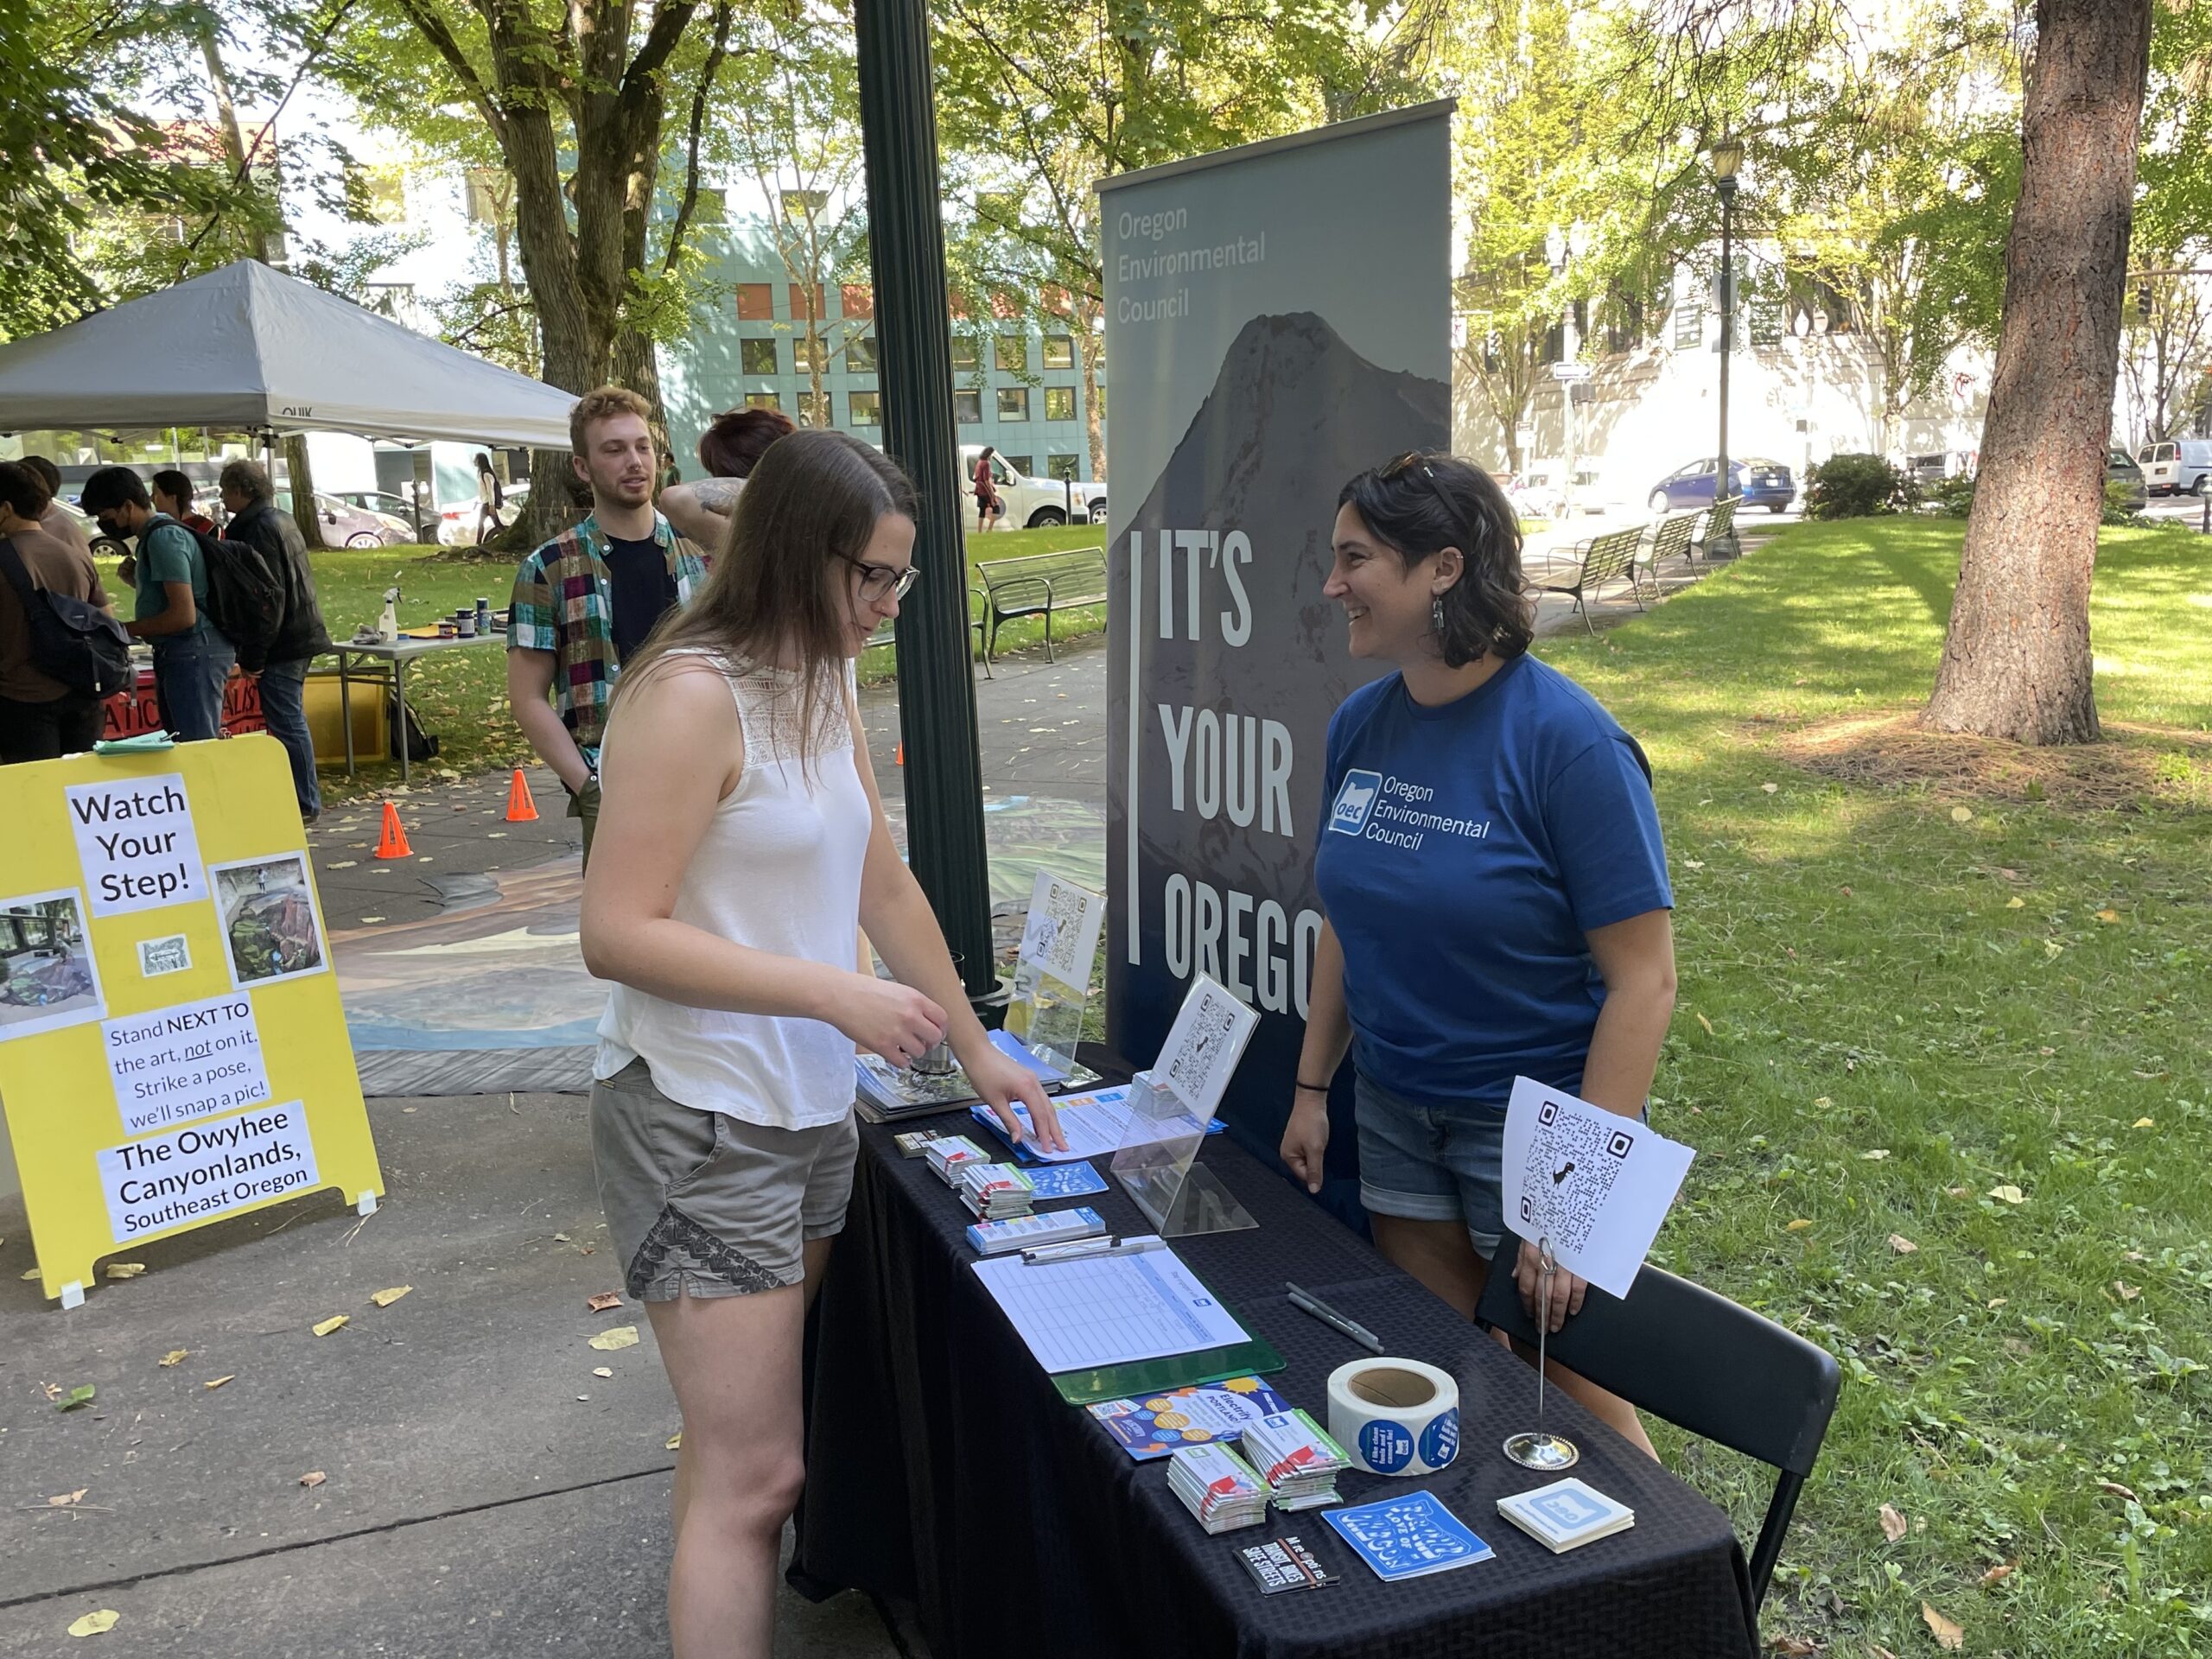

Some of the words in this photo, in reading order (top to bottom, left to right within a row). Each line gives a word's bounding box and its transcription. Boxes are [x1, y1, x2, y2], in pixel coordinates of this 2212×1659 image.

[1119, 207, 1187, 241] Oregon
[1119, 231, 1265, 283] Environmental
[1117, 288, 1189, 324] Council
[1159, 529, 1253, 648] IT'S
[1158, 703, 1294, 838] YOUR
[1383, 776, 1433, 803] Oregon
[72, 785, 186, 824] Watch
[1337, 802, 1363, 820] oec
[1374, 799, 1491, 840] Environmental
[96, 832, 176, 861] Your
[1366, 822, 1424, 851] Council
[100, 863, 189, 902] Step!
[1165, 873, 1324, 1022] OREGO
[111, 1021, 163, 1046] Stand
[167, 1009, 218, 1034] NEXT
[222, 1002, 250, 1020] TO
[115, 1053, 145, 1075] the
[149, 1047, 181, 1067] art,
[184, 1039, 213, 1062] not
[215, 1035, 238, 1051] on
[240, 1029, 258, 1046] it.
[134, 1074, 188, 1099] Strike
[193, 1072, 203, 1085] a
[206, 1062, 251, 1085] pose,
[130, 1105, 171, 1129] we'll
[175, 1096, 217, 1119] snap
[221, 1092, 232, 1105] a
[234, 1081, 266, 1103] pic!
[117, 1142, 172, 1172] The
[177, 1111, 289, 1155] Owyhee
[119, 1141, 302, 1205] Canyonlands,
[124, 1192, 230, 1232] Southeast
[233, 1167, 308, 1200] Oregon
[1220, 1394, 1254, 1421] Electrify
[1384, 1512, 1408, 1535] LOVE
[1400, 1537, 1412, 1549] OF
